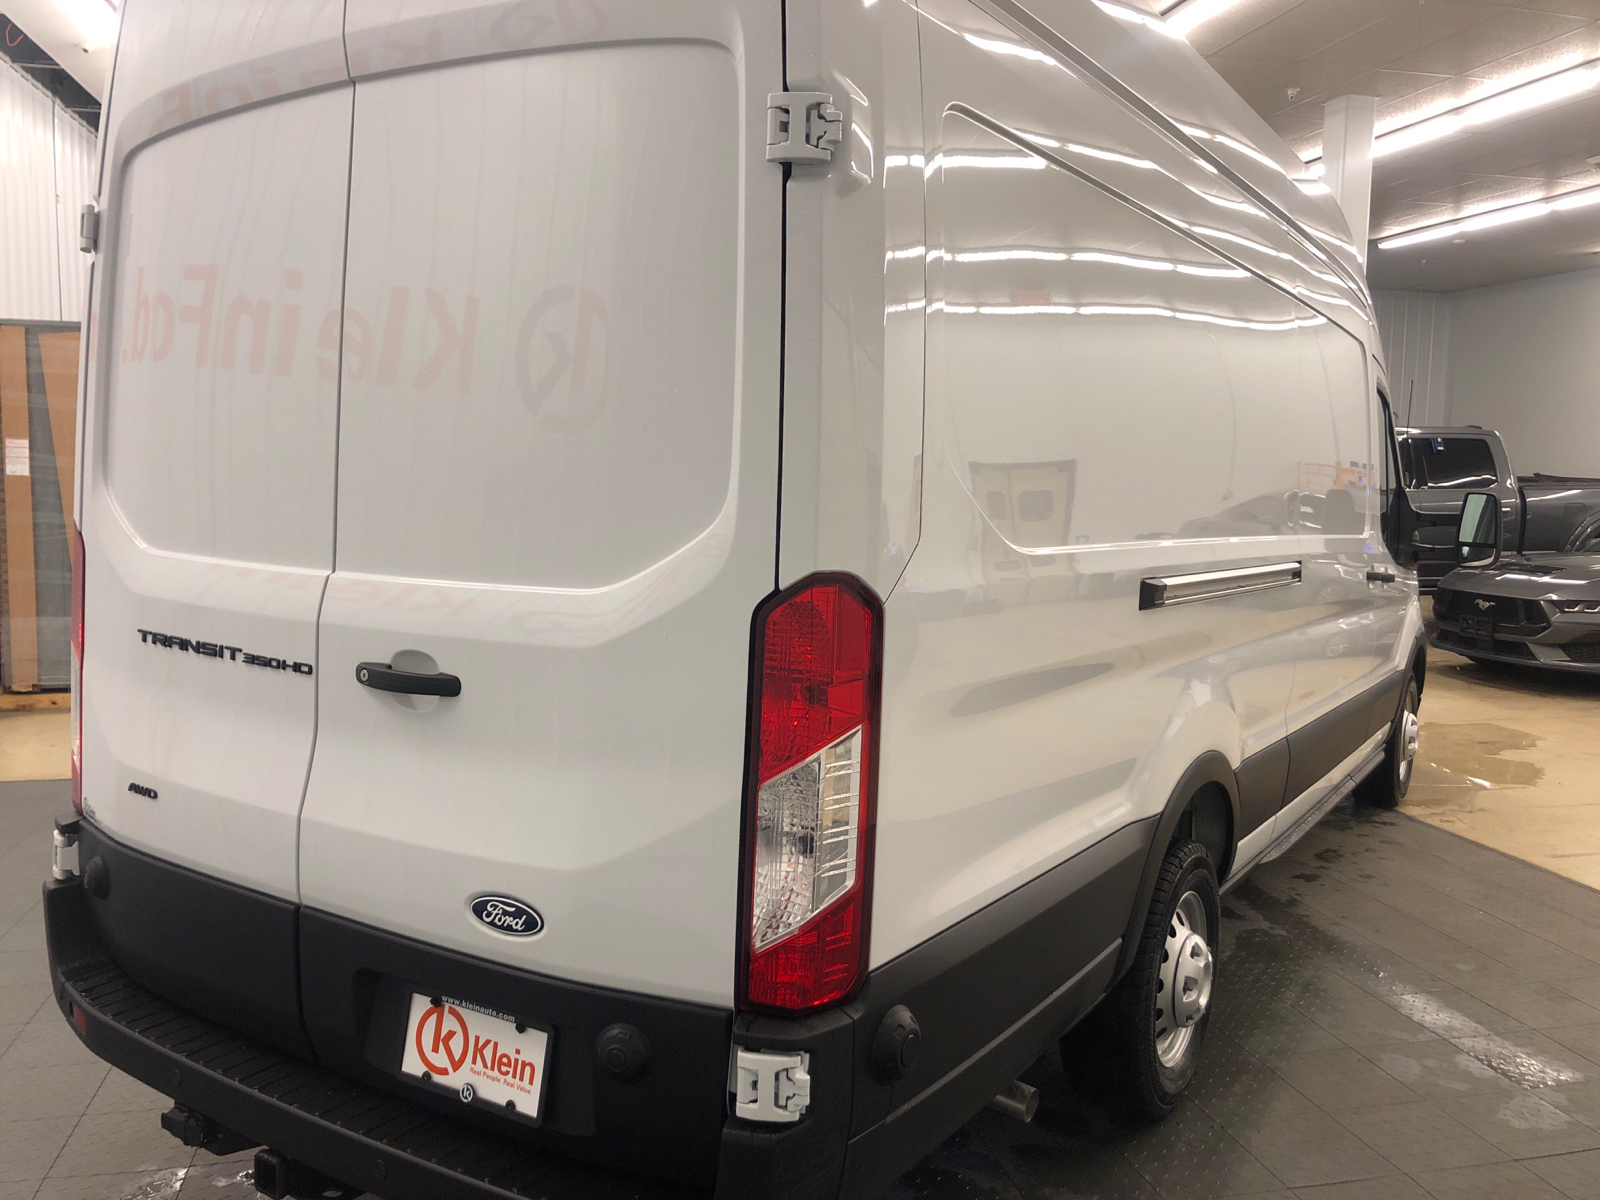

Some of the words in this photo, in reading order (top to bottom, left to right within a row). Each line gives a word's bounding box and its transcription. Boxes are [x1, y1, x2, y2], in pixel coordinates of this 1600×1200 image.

[137, 629, 242, 661] TRANSIT
[128, 782, 158, 800] AWD
[482, 901, 527, 931] Ford
[441, 995, 515, 1023] www.kleinauto.com
[471, 1035, 536, 1086] Klein
[469, 1066, 482, 1077] Real
[482, 1071, 502, 1084] People.
[503, 1078, 515, 1089] Real
